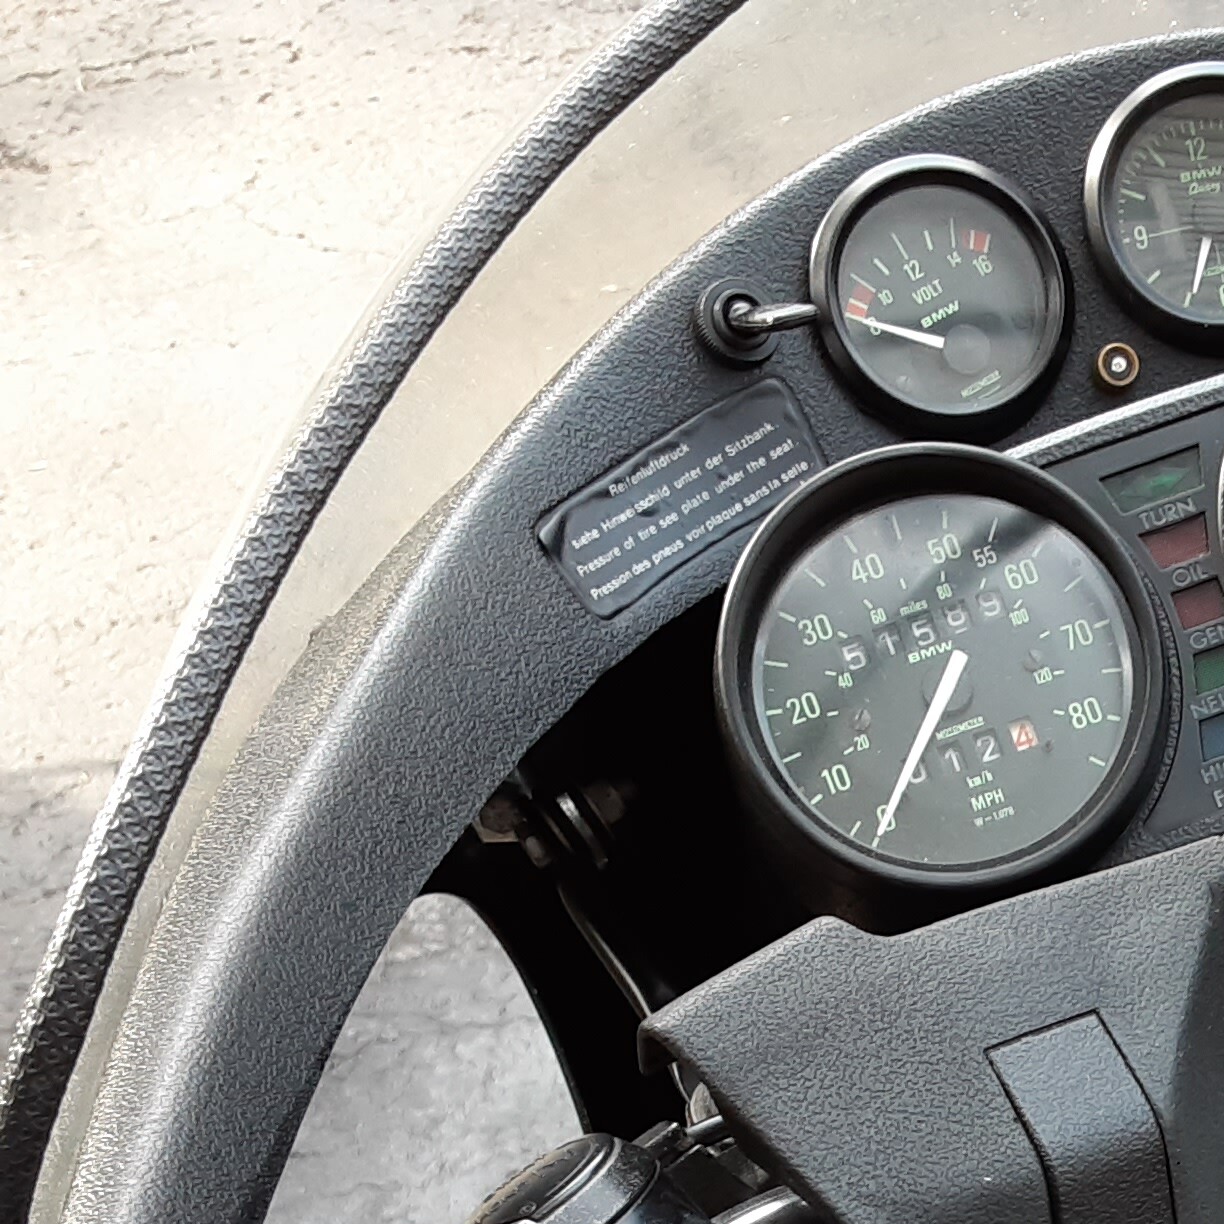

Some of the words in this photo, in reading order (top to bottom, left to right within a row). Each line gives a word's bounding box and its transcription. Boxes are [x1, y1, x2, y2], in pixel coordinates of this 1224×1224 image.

[1185, 137, 1208, 161] 12
[1180, 166, 1222, 183] BMW
[1134, 225, 1148, 250] 9
[903, 259, 925, 282] 12
[946, 251, 962, 269] 14
[972, 254, 994, 278] 16
[878, 290, 894, 306] 10
[912, 278, 944, 306] VOLT
[920, 300, 960, 329] BMW
[608, 442, 690, 497] Reifenluftdruck
[674, 467, 702, 489] unter
[705, 454, 724, 470] der
[576, 546, 622, 578] Pressure
[624, 536, 636, 550] of
[659, 512, 679, 529] see
[681, 491, 710, 515] plate
[715, 470, 745, 494] under
[746, 456, 767, 474] the
[1138, 499, 1198, 531] TURN
[590, 570, 633, 600] Pression
[632, 560, 652, 576] des
[652, 540, 684, 565] pneus
[686, 524, 705, 542] voir
[706, 502, 743, 531] plaque
[768, 479, 781, 491] la
[926, 534, 963, 564] 50
[851, 554, 885, 584] 40
[972, 546, 997, 568] 55
[1004, 559, 1039, 589] 60
[1172, 564, 1209, 588] OIL
[936, 584, 953, 600] 80
[870, 608, 887, 625] 60
[900, 600, 928, 616] miles
[1009, 608, 1030, 626] 100
[799, 614, 833, 646] 30
[1060, 620, 1094, 651] 70
[908, 640, 953, 665] BMW
[838, 673, 853, 689] 40
[1033, 668, 1052, 685] 120
[786, 692, 822, 725] 20
[1068, 696, 1103, 730] 80
[854, 734, 870, 751] 20
[820, 764, 851, 794] 10
[966, 770, 993, 789] km/h
[970, 788, 1005, 812] MPH
